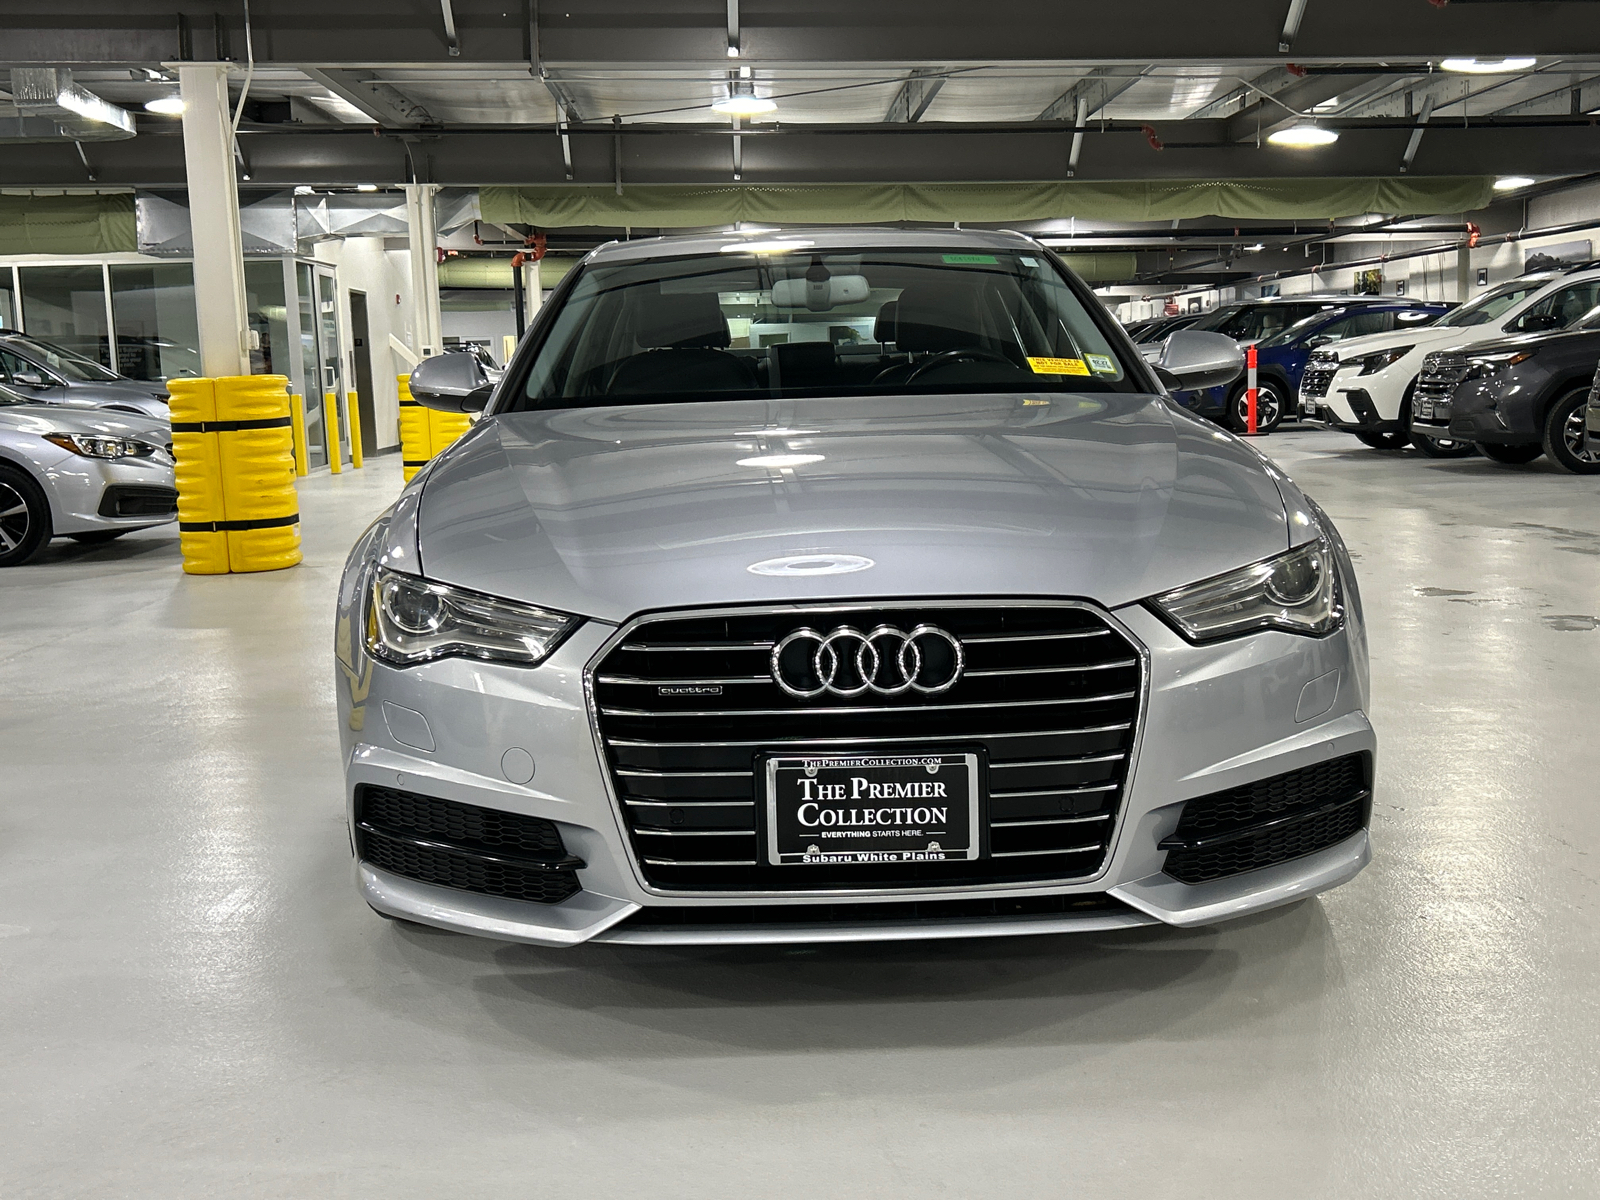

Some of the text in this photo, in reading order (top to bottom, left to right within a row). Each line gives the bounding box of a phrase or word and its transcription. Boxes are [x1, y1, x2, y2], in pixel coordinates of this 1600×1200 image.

[797, 777, 948, 800] THE PREMIER
[797, 803, 948, 827] COLLECTION
[872, 830, 900, 838] STARTS
[901, 829, 924, 837] HERE.
[802, 851, 946, 863] Subaru White Plains
